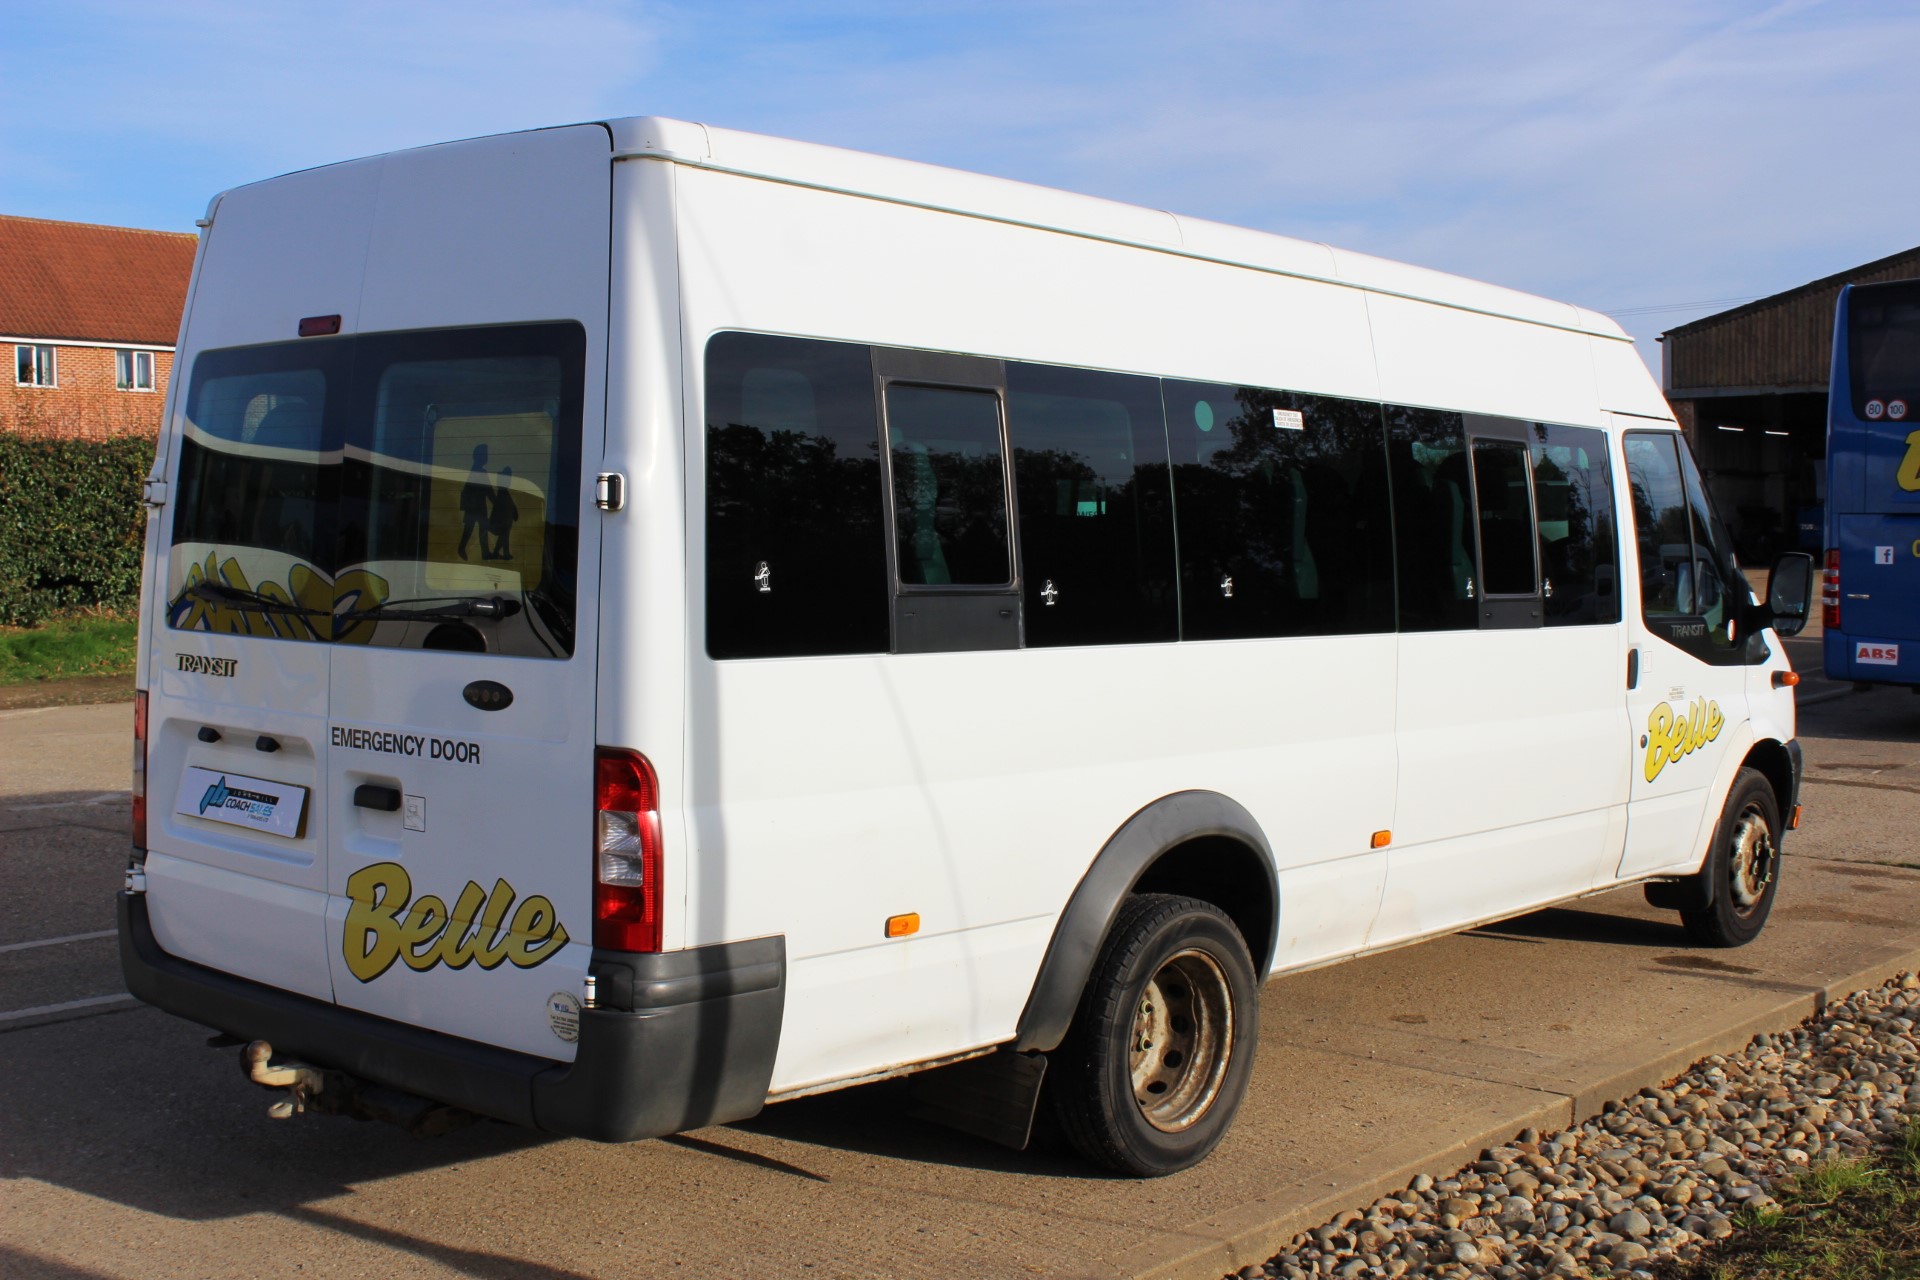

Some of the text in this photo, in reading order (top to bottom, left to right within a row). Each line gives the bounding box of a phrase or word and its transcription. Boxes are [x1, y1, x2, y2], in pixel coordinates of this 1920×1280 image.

[1868, 403, 1881, 415] 80
[1889, 404, 1904, 415] 100
[1671, 624, 1705, 638] TRANSIT
[1857, 647, 1897, 661] ABS
[175, 653, 238, 677] TRANSIT
[331, 726, 481, 765] EMERGENCY DOOR
[1644, 695, 1726, 783] Belle
[342, 861, 571, 984] Belle
